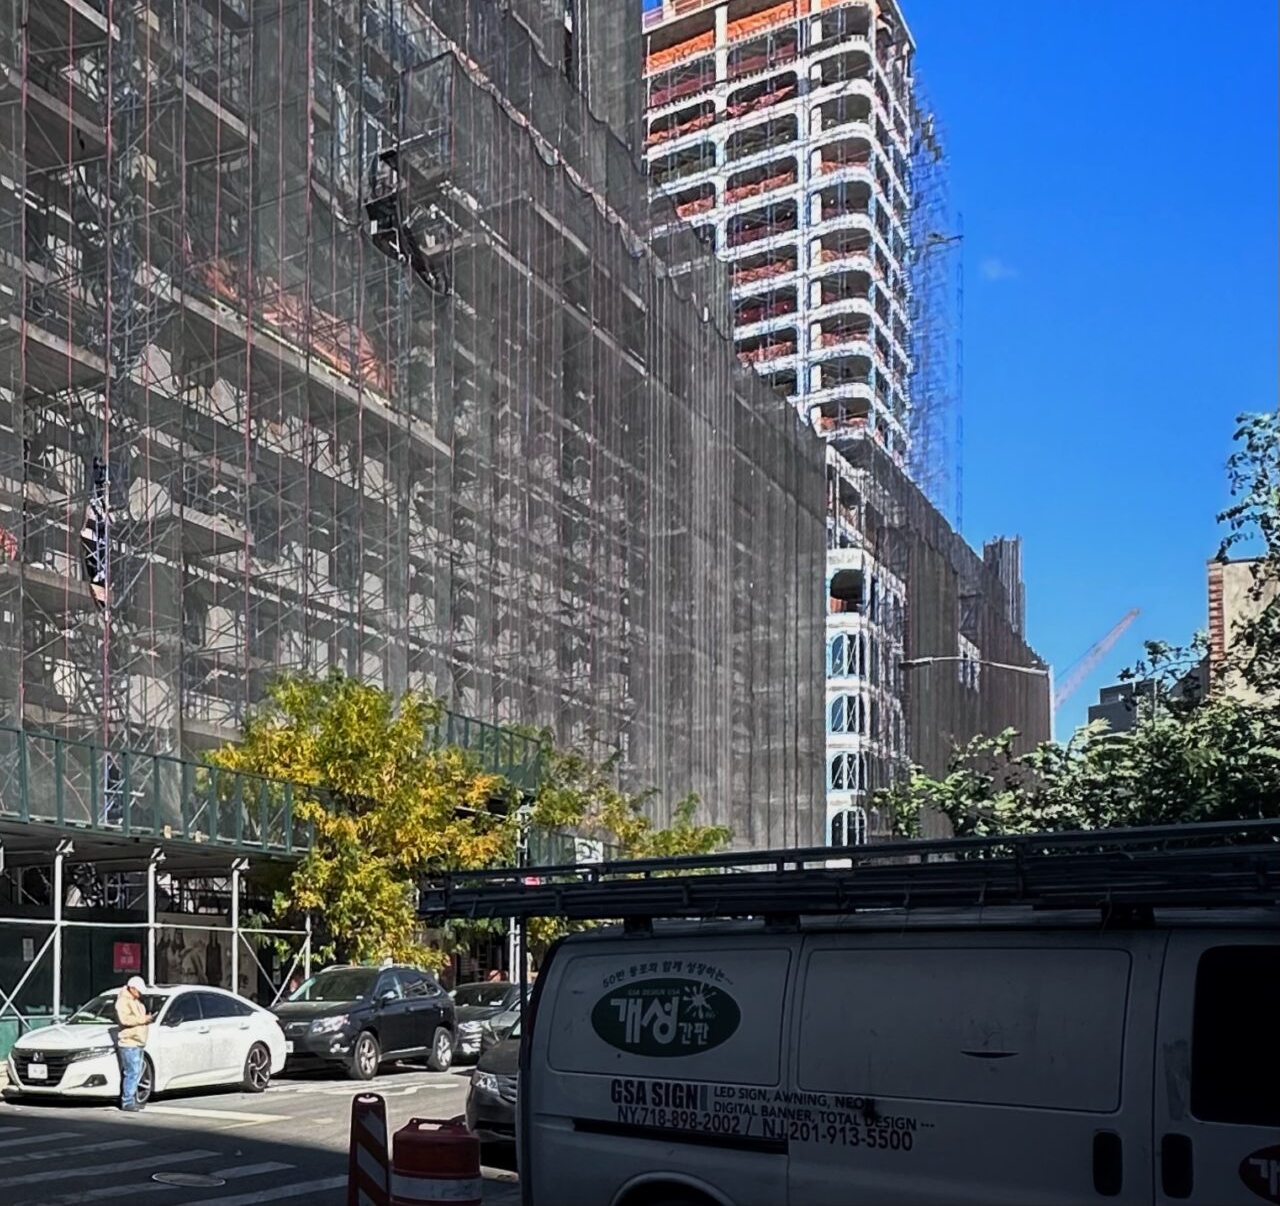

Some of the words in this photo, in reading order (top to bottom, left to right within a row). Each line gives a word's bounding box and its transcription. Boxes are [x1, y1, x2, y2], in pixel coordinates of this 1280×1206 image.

[609, 996, 680, 1045] 개성
[678, 1022, 710, 1045] 간판
[611, 1078, 647, 1106] GSA
[651, 1081, 699, 1110] SIGN
[714, 1086, 736, 1098] LED
[738, 1088, 770, 1102] SIGN,
[774, 1090, 830, 1109] AWNING,
[617, 1105, 741, 1134] NY.718-898-2002
[714, 1101, 759, 1117] DIGITAL
[761, 1105, 815, 1123] BANNER,
[819, 1111, 861, 1127] TOTAL
[865, 1115, 917, 1131] DESIGN
